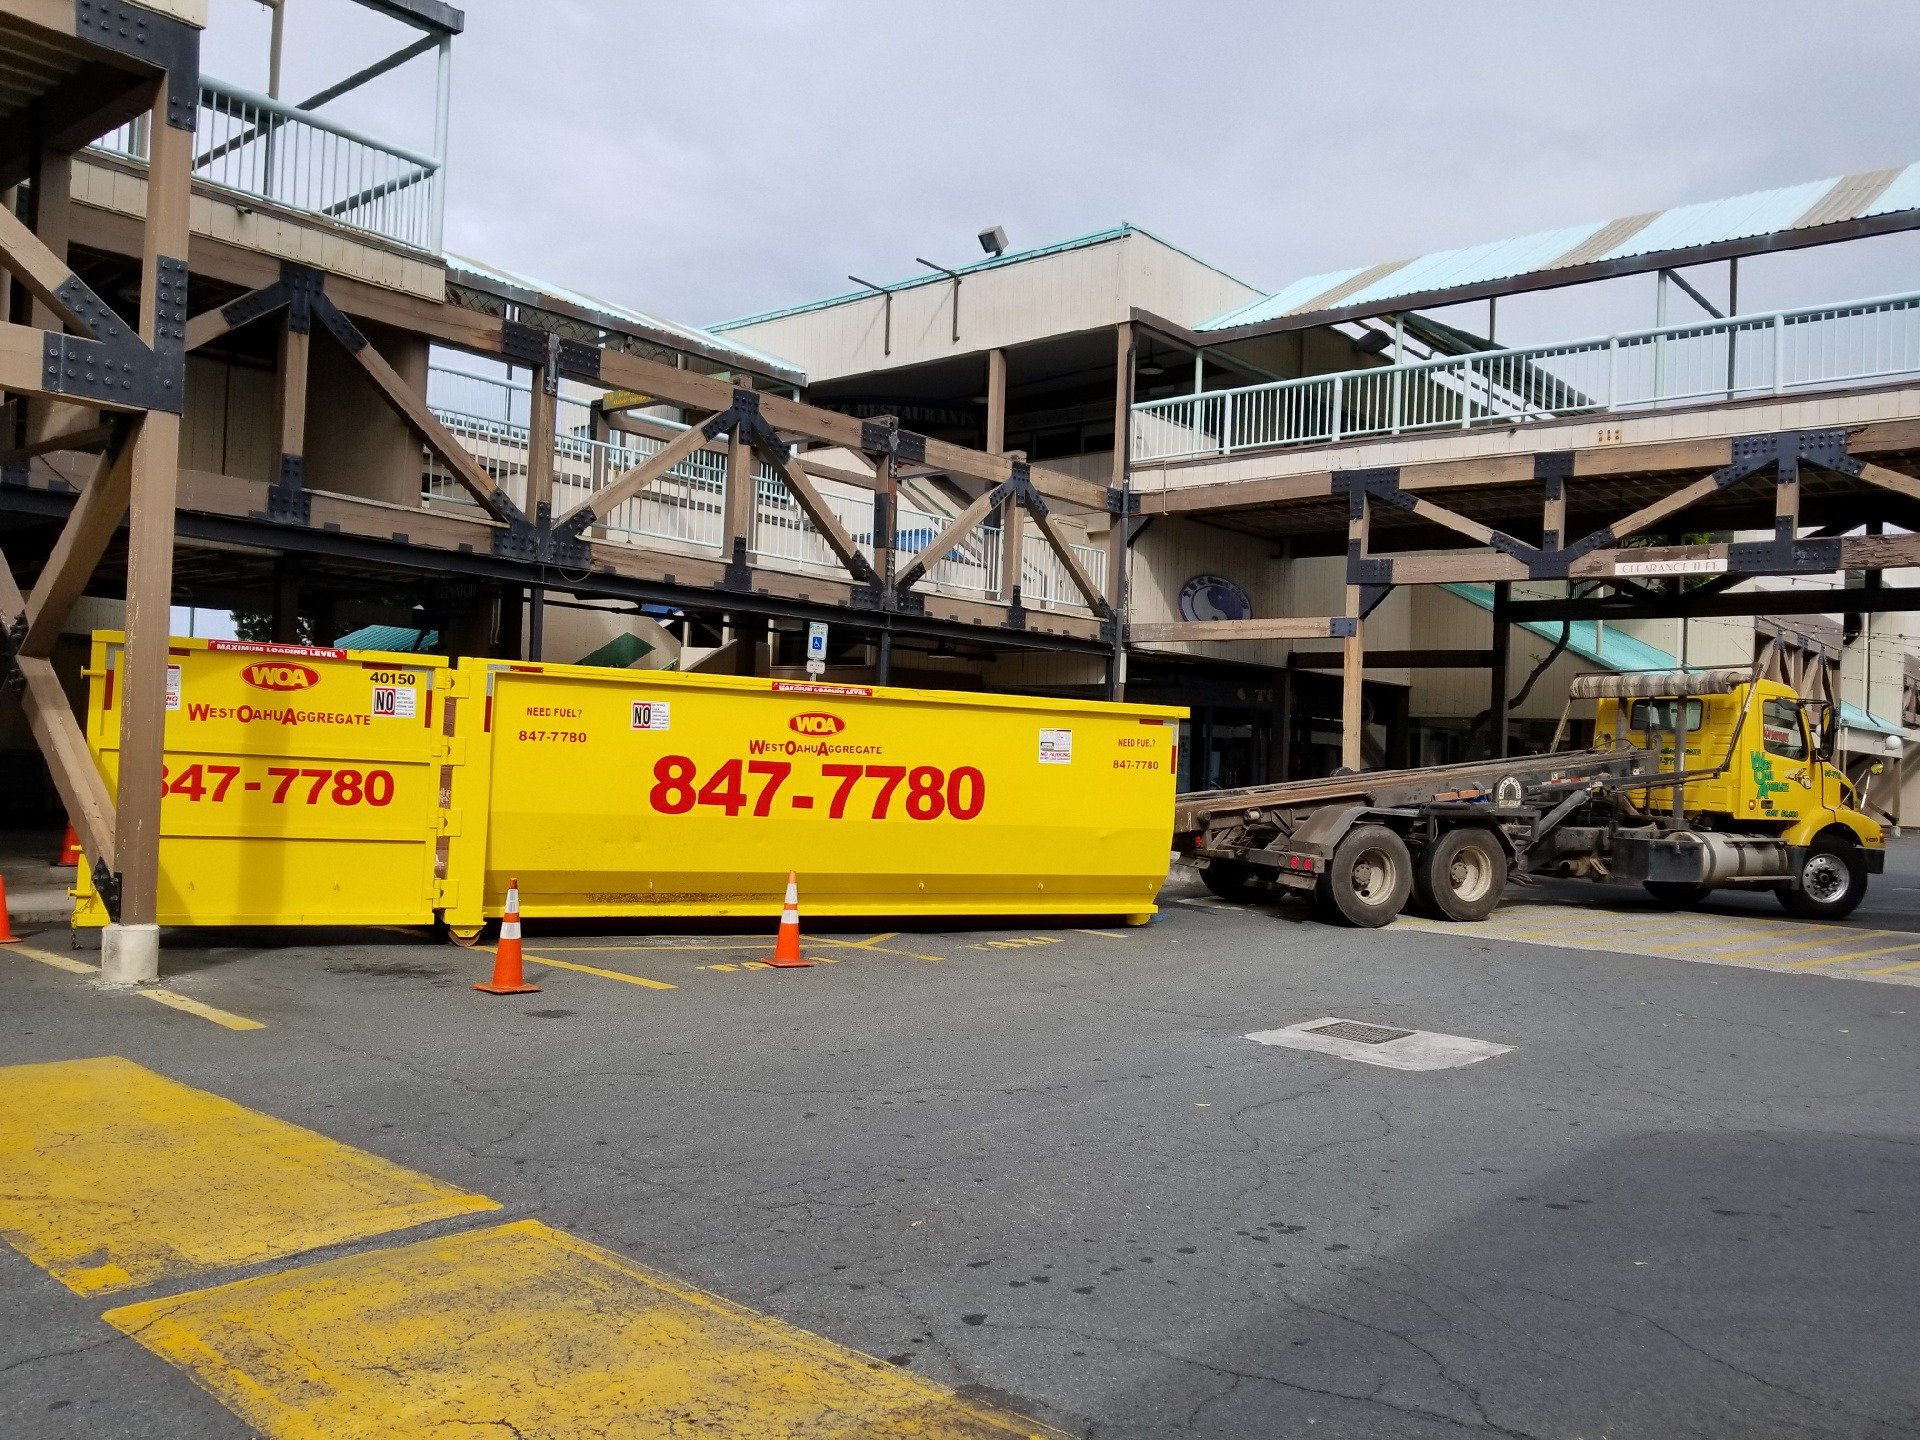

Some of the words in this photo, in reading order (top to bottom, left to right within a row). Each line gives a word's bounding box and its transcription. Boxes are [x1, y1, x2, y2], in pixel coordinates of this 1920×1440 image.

[1622, 562, 1687, 574] CLEARANCE
[216, 643, 264, 652] MAXIMUM
[266, 647, 307, 656] LOADING
[309, 649, 338, 658] LEVEL
[251, 666, 309, 687] WOA
[368, 671, 416, 686] 40150
[376, 690, 395, 712] NO
[526, 707, 551, 717] NEED
[554, 708, 583, 719] FUEL?
[633, 705, 651, 728] NO
[795, 716, 838, 733] WOA
[518, 730, 587, 743] 847-7780
[1118, 738, 1135, 747] NEED
[1113, 759, 1159, 770] 847-7780
[161, 763, 394, 807] 47-7780
[650, 754, 986, 819] 847-7780
